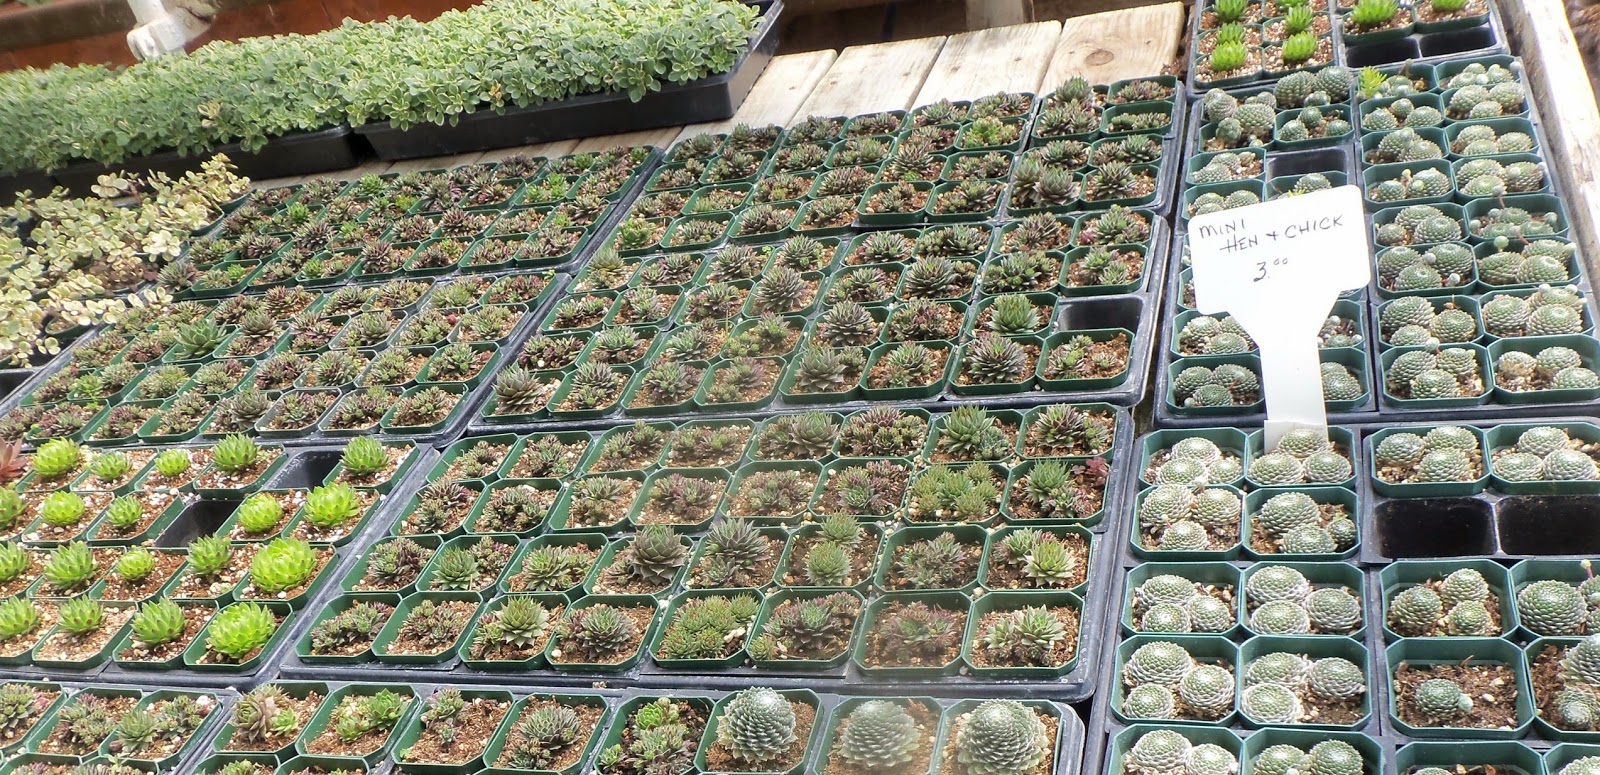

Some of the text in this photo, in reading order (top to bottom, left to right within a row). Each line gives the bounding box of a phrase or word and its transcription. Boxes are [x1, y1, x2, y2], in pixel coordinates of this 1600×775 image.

[1199, 218, 1245, 239] MINI
[1219, 235, 1258, 253] HEN
[1284, 214, 1343, 239] CHICK
